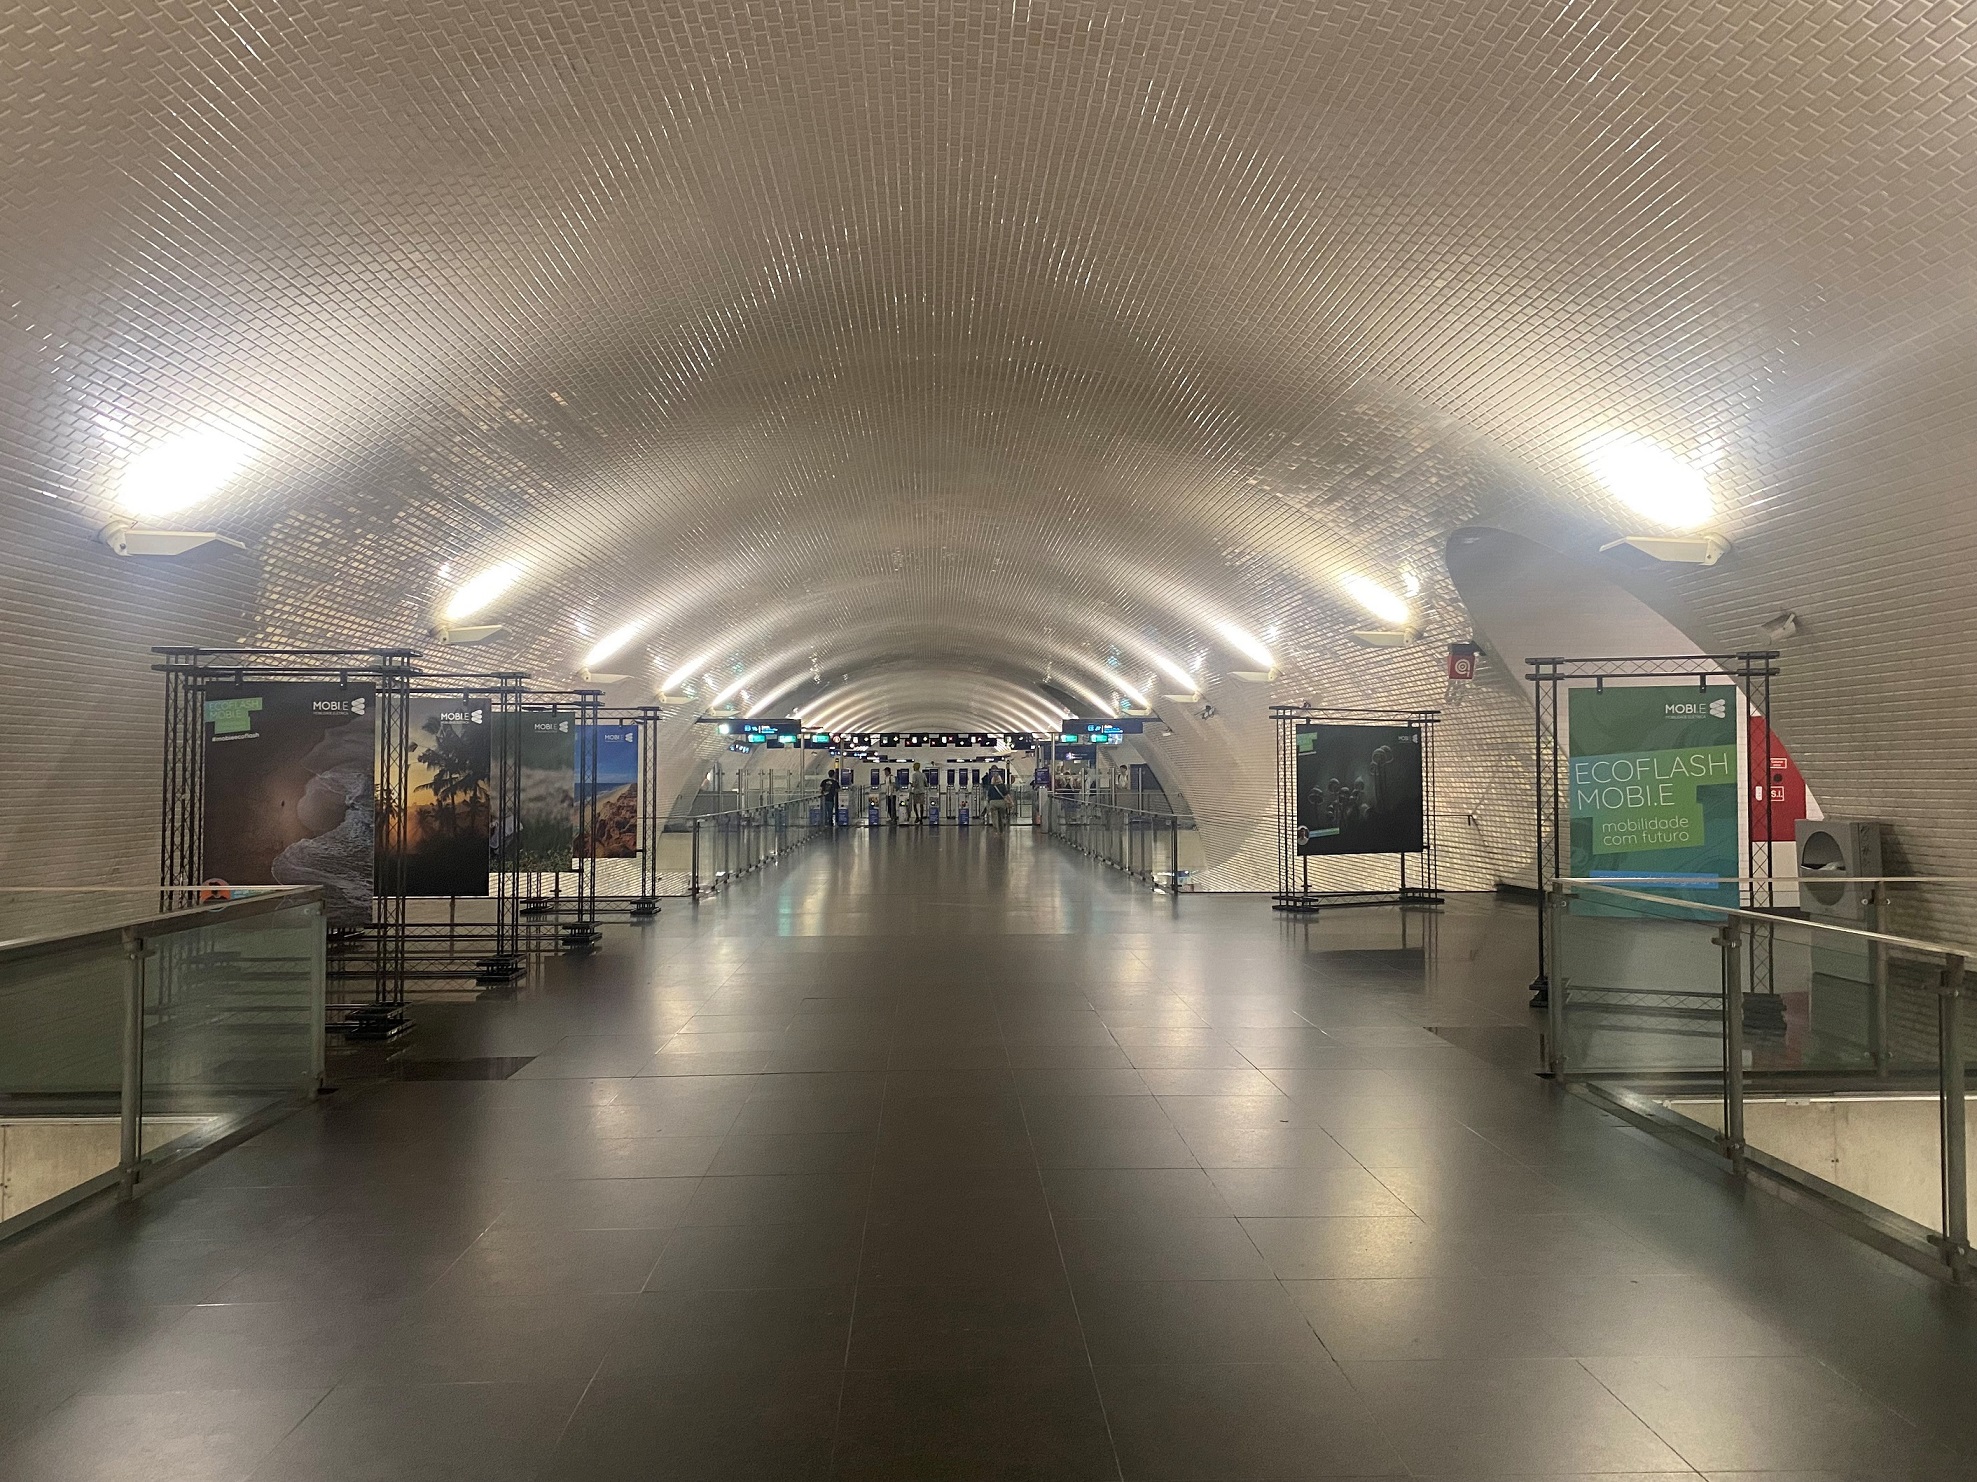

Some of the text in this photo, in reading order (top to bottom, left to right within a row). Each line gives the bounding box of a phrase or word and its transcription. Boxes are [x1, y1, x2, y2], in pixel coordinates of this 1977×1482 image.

[1575, 752, 1729, 785] ECOFLASH
[1577, 783, 1676, 811] MOBI.E
[1602, 815, 1690, 833] mobilidade
[1603, 830, 1690, 846] com futuro
